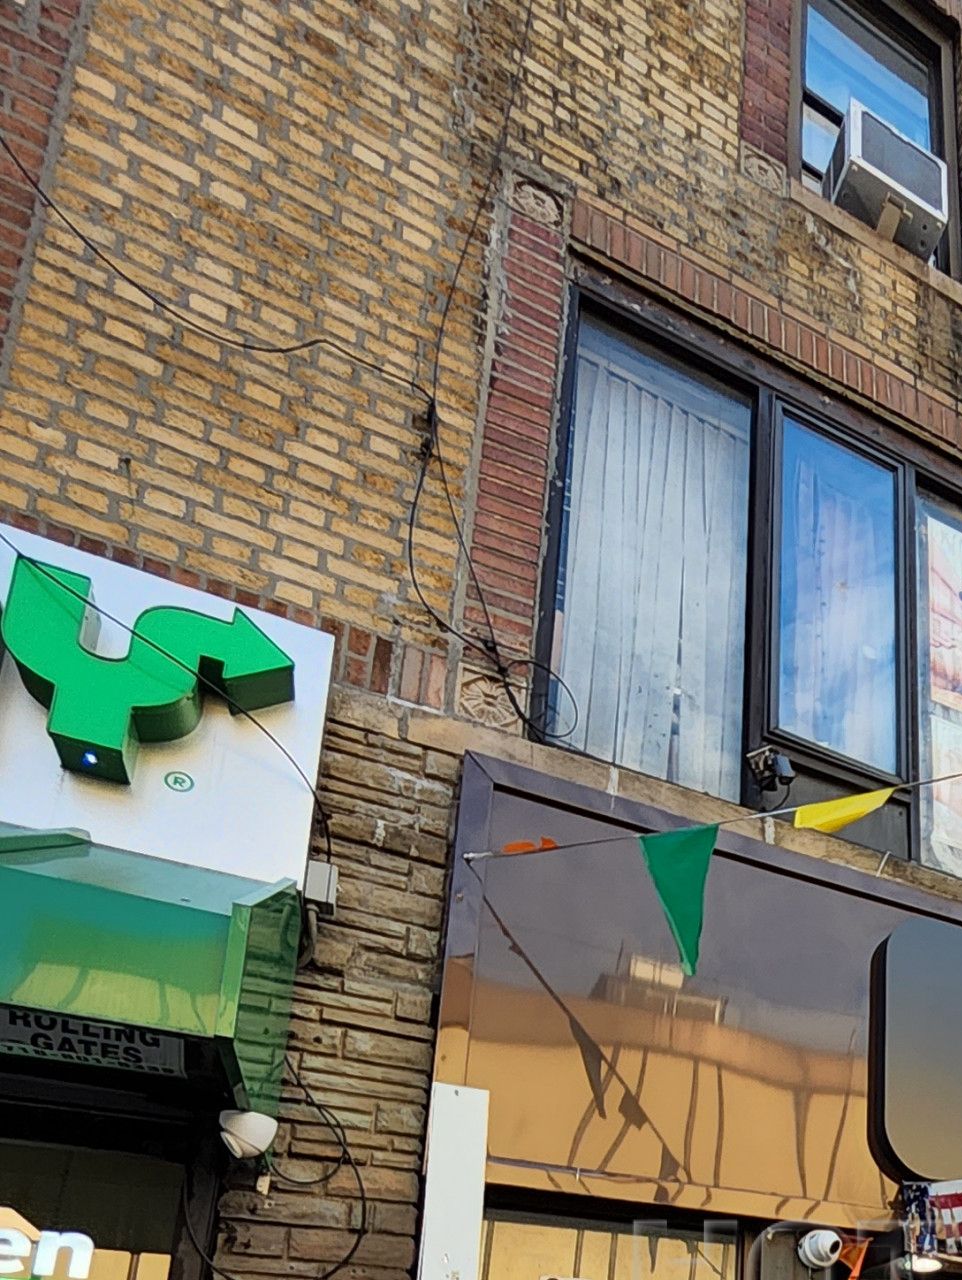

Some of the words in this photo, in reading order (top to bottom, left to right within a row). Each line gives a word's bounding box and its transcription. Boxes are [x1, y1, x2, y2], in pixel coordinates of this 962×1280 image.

[9, 1009, 161, 1049] ROLLING
[30, 1033, 144, 1064] GATES
[0, 1228, 95, 1279] en
